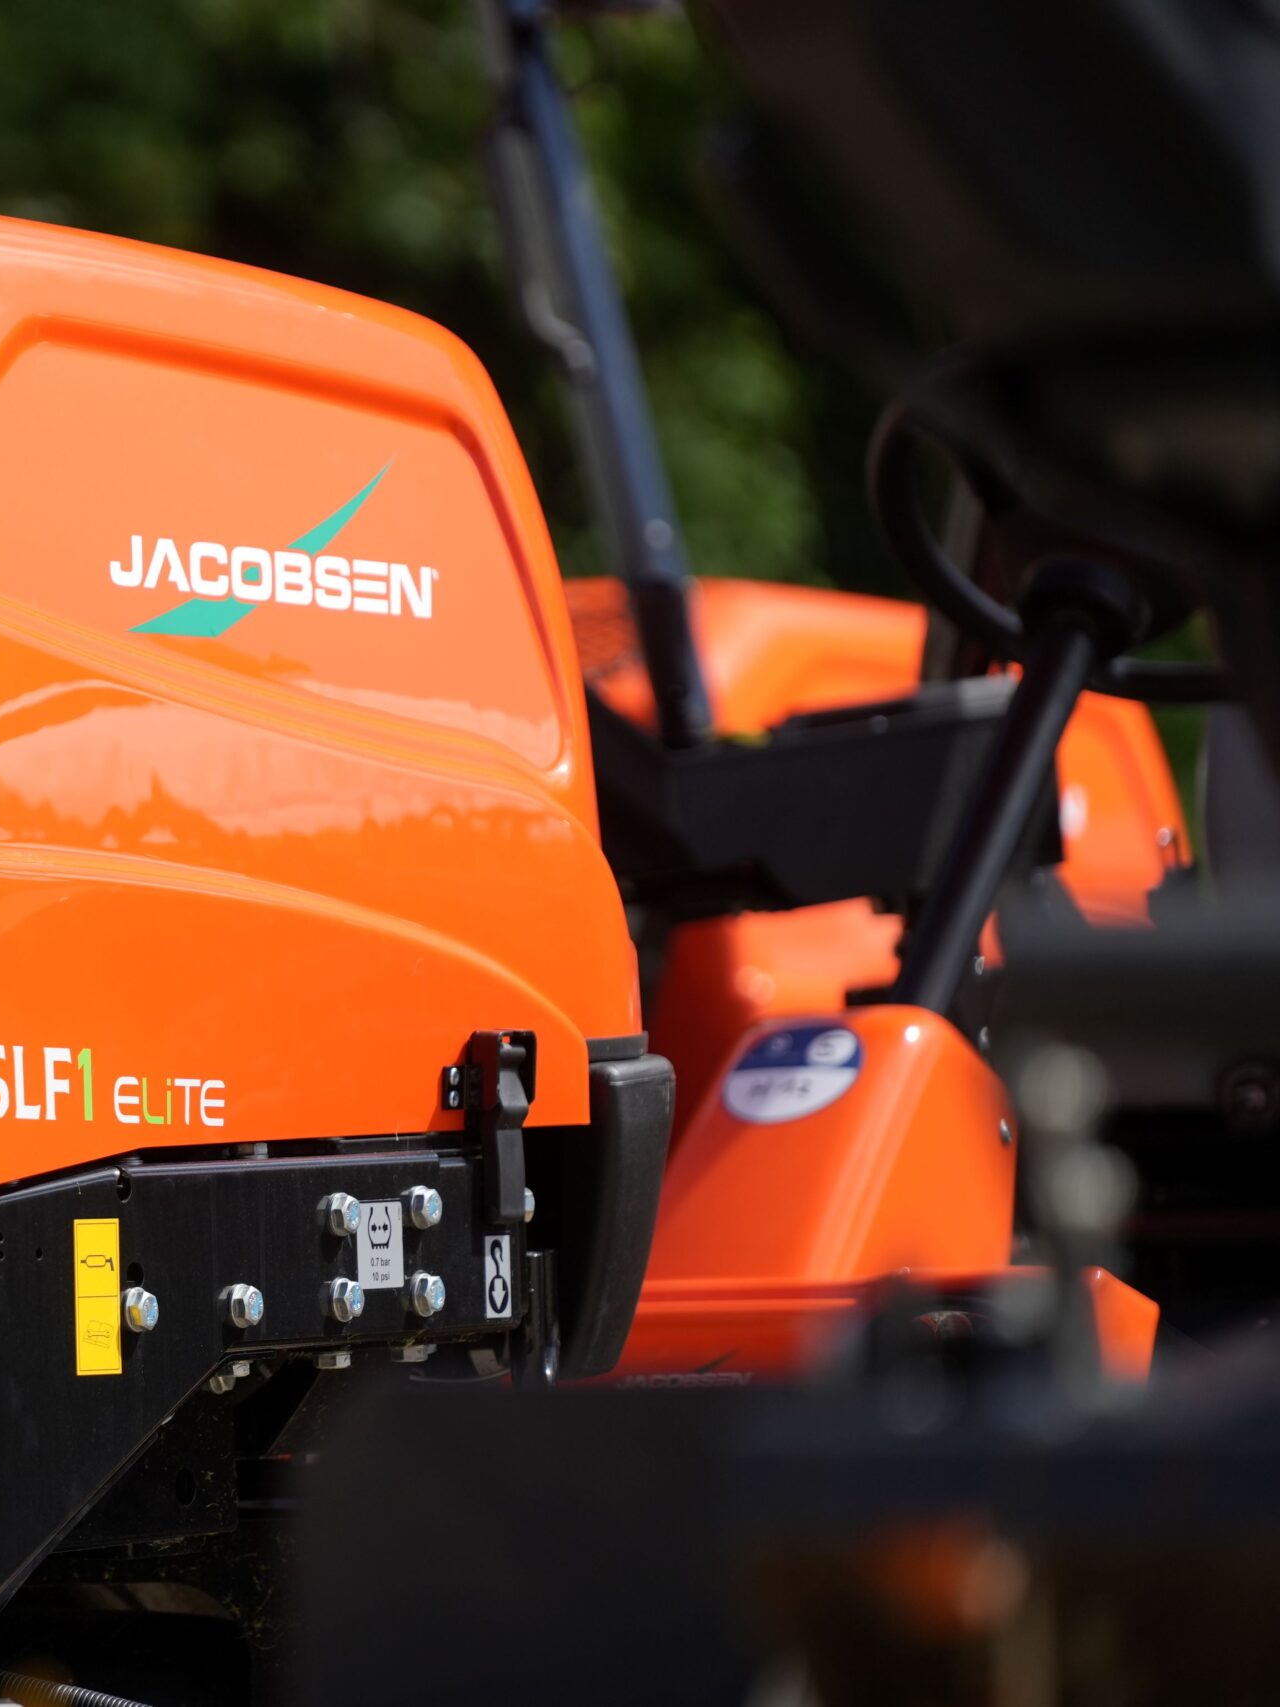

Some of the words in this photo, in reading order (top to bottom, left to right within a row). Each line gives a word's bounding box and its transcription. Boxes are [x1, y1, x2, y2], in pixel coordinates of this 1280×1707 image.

[109, 534, 433, 619] JACOBSEN
[370, 1257, 380, 1267] 0.7
[380, 1257, 391, 1267] bar
[372, 1271, 380, 1281] 10
[380, 1271, 391, 1283] psi
[617, 1371, 753, 1390] JACOBSEN
